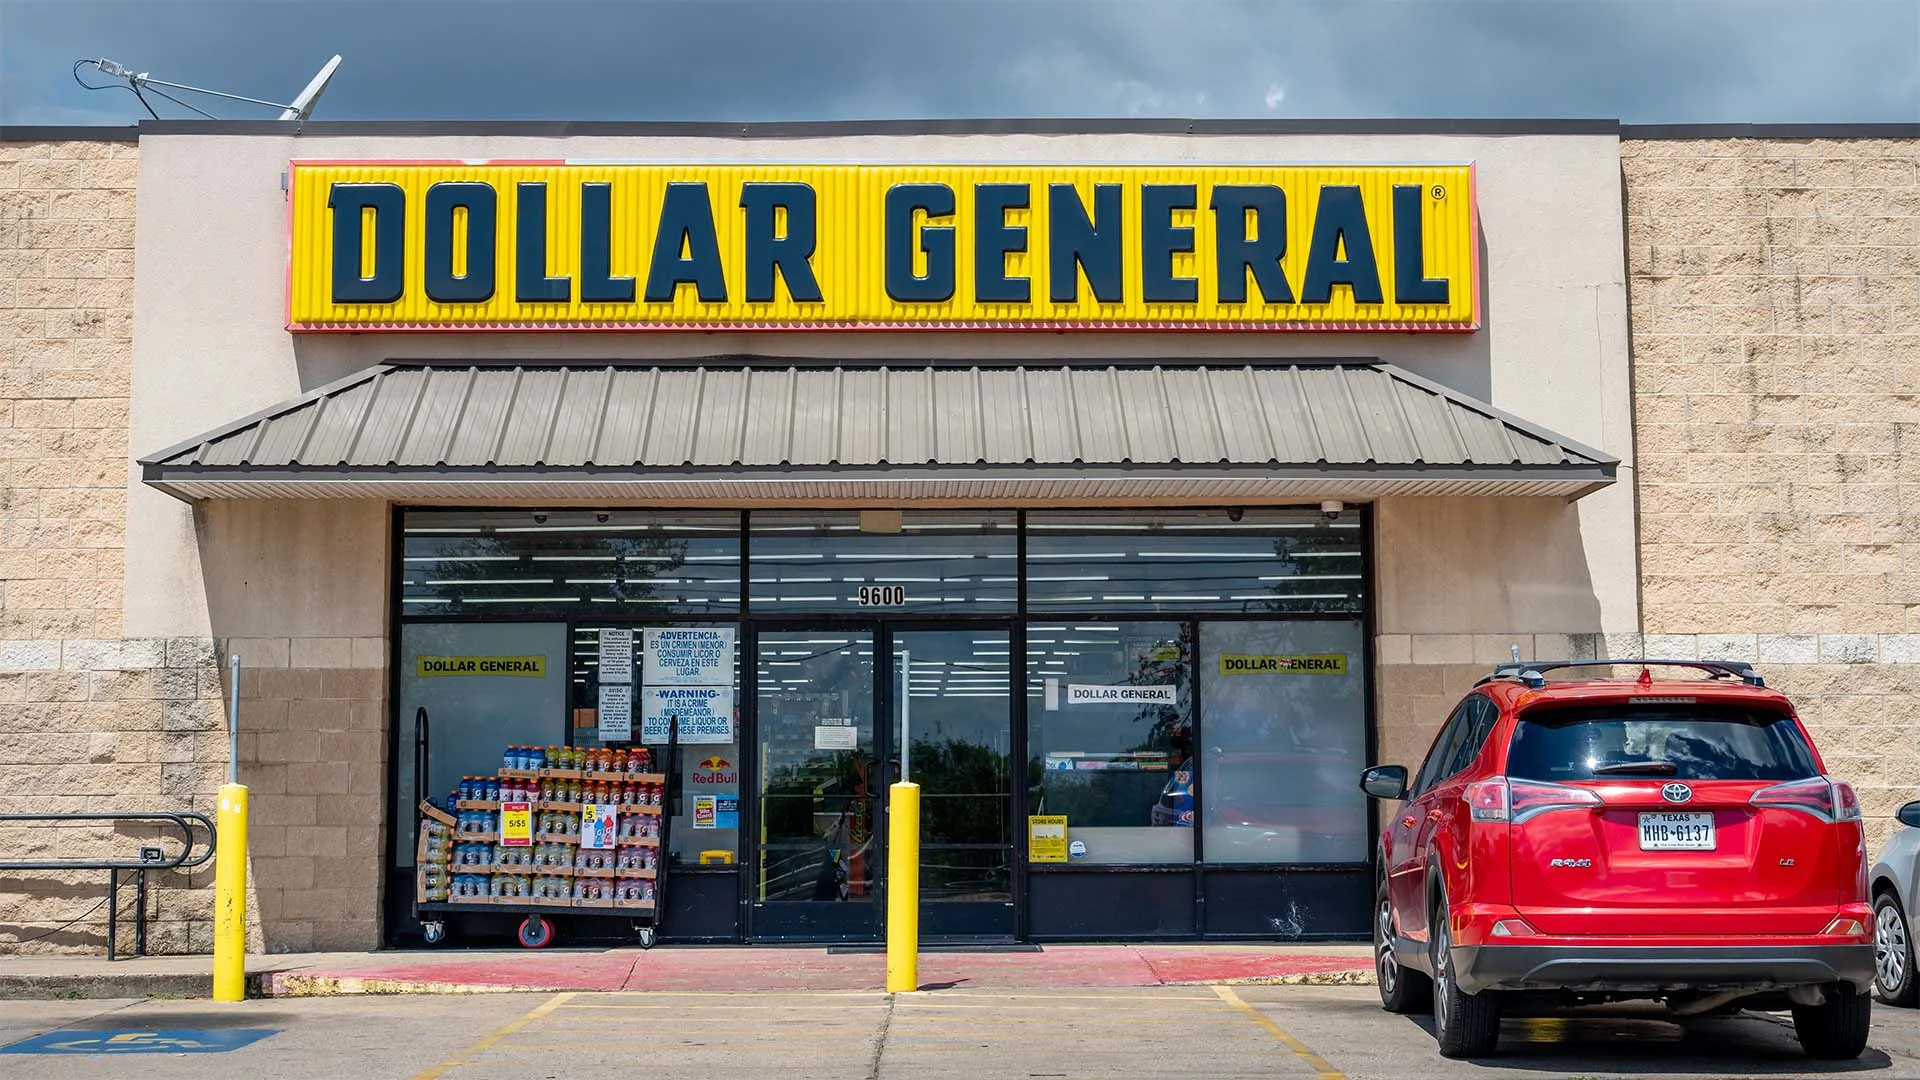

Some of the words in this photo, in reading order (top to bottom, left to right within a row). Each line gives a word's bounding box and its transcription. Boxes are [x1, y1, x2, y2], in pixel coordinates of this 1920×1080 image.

[327, 181, 824, 304] DOLLAR
[884, 182, 1450, 304] GENERAL
[860, 587, 904, 605] 9600
[650, 641, 659, 649] ES
[660, 641, 671, 649] UN
[671, 641, 697, 649] CRIMEN
[698, 641, 727, 649] (MENOR)
[657, 650, 692, 658] CONSUMIR
[694, 650, 714, 658] LICOR
[715, 650, 721, 658] O
[424, 660, 476, 672] DOLLAR
[480, 660, 540, 672] GENERAL
[659, 658, 690, 667] CERVEZA
[691, 659, 700, 667] EN
[702, 659, 719, 667] ESTE
[1224, 659, 1277, 670] DOLLAR
[1074, 689, 1118, 699] DOLLAR
[1120, 690, 1171, 699] GENERAL
[667, 699, 674, 708] IT
[674, 699, 681, 708] IS
[681, 699, 687, 708] A
[688, 699, 708, 708] CRIME
[648, 718, 657, 726] TO
[692, 718, 716, 726] LIQUOR
[717, 718, 727, 726] OR
[645, 726, 663, 735] BEER
[692, 772, 714, 784] Red
[716, 772, 737, 784] Bull
